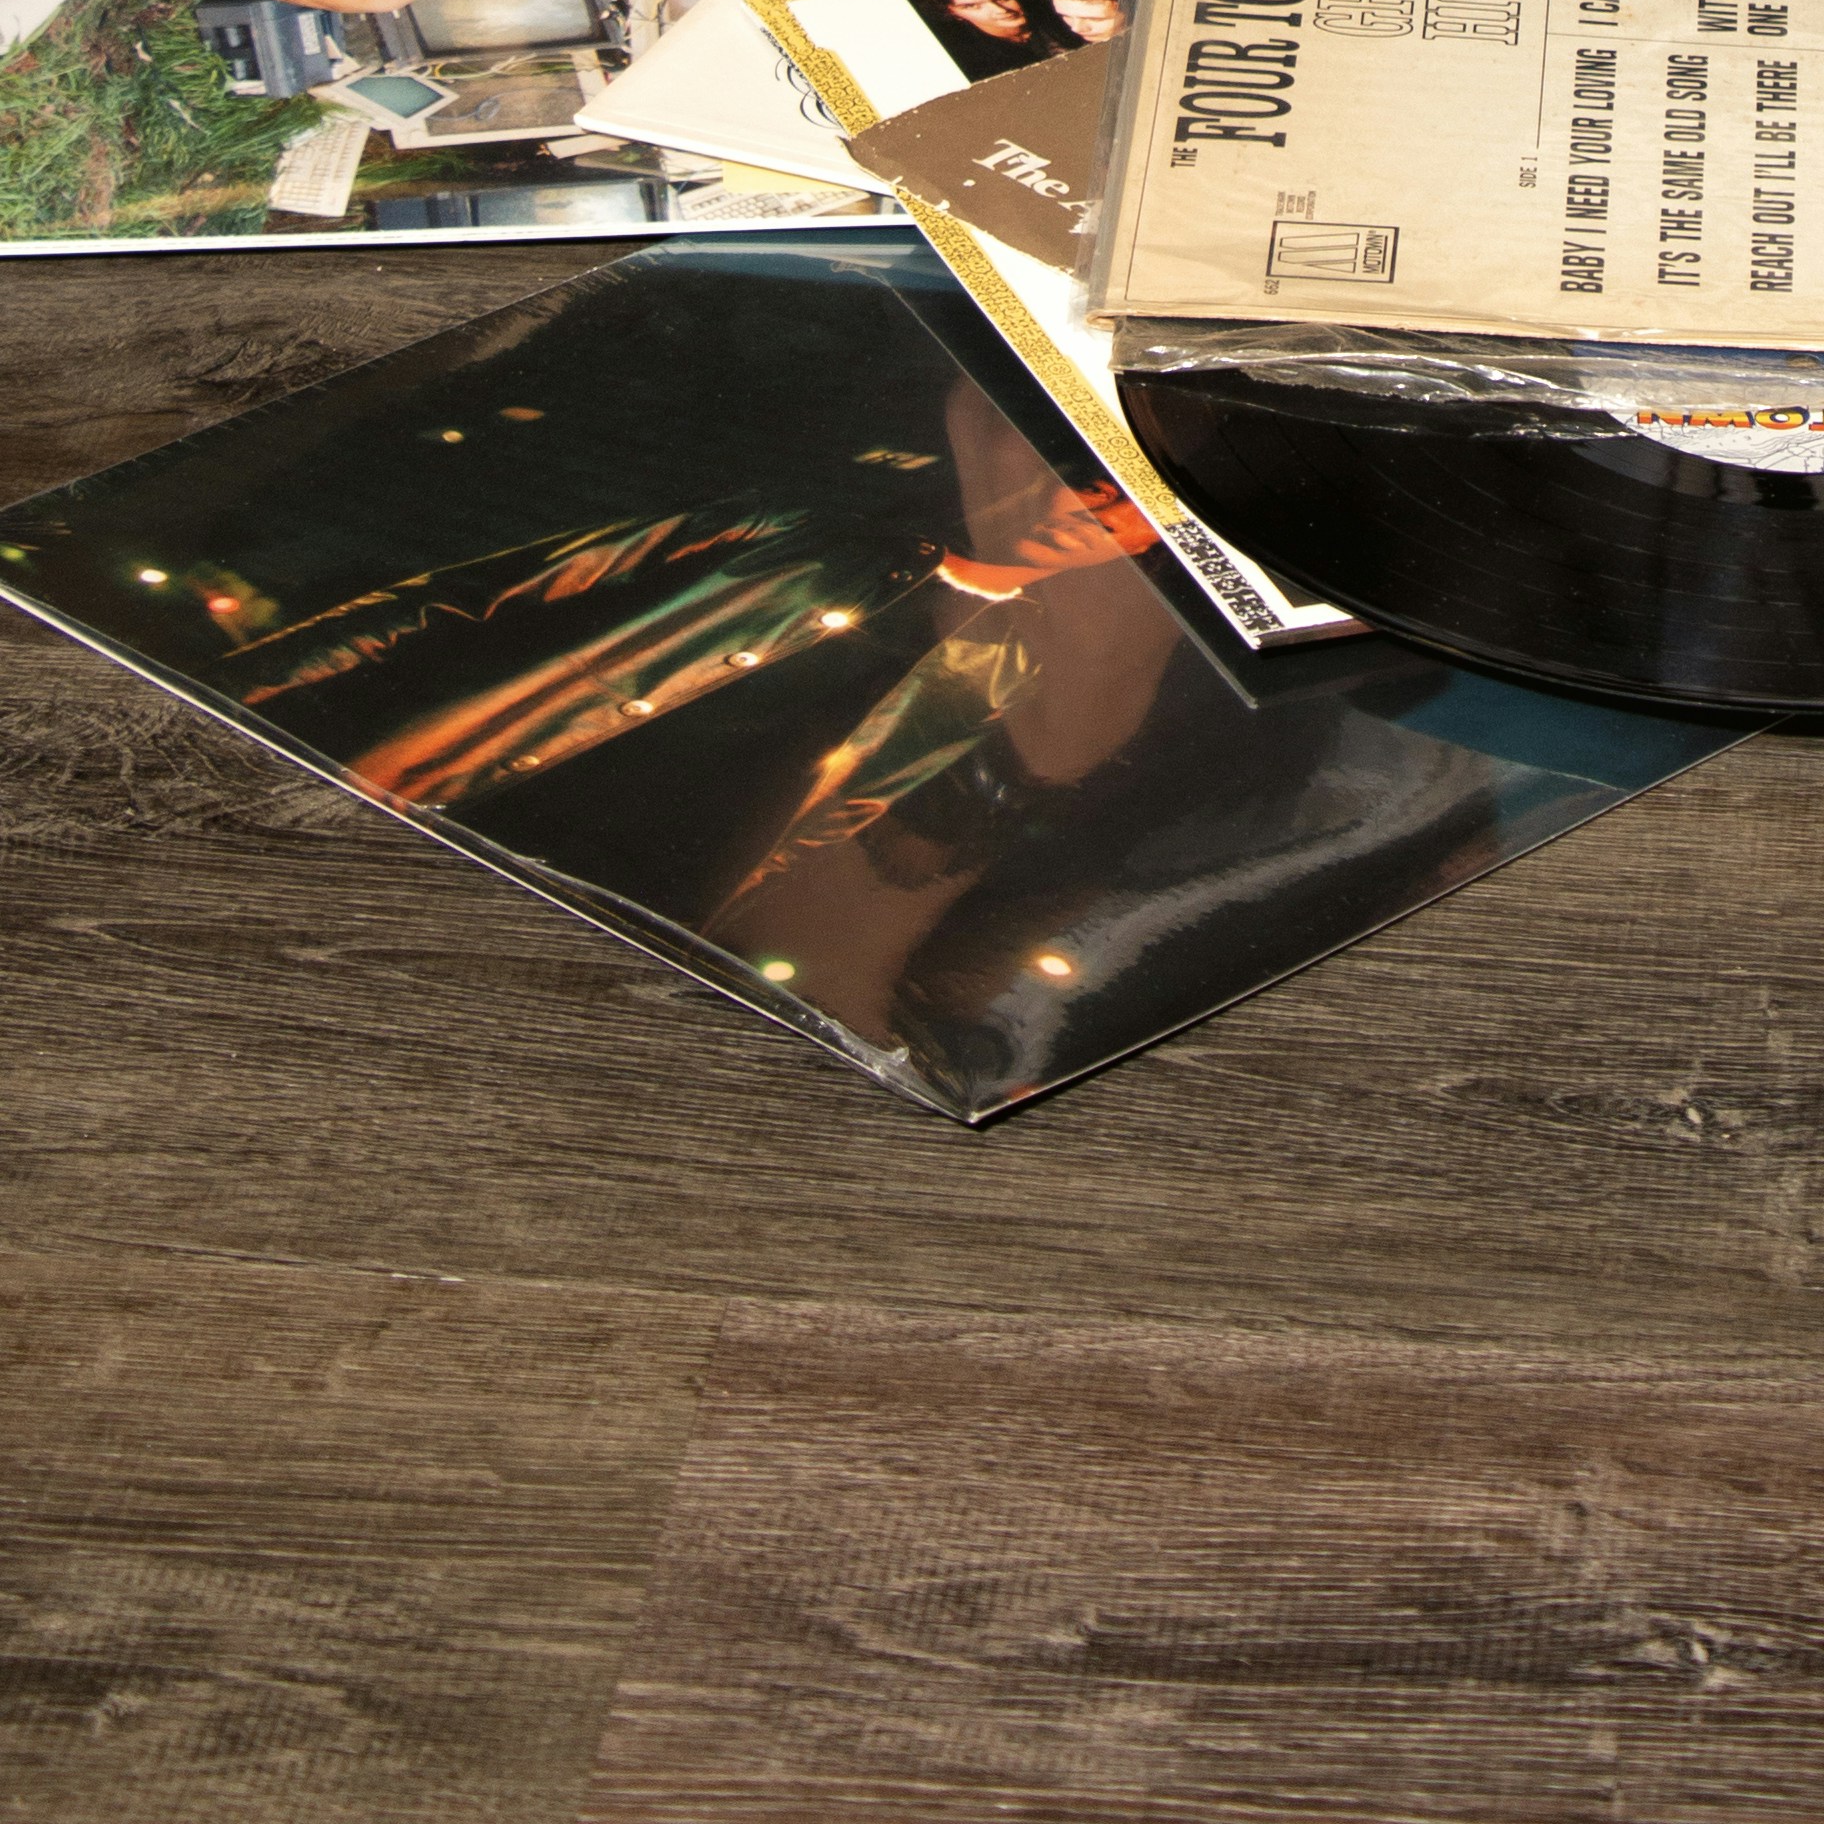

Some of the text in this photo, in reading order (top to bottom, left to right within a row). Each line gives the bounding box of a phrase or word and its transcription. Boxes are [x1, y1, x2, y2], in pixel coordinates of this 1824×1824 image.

[1747, 4, 1788, 36] ONE
[1174, 39, 1300, 147] FOUR
[1573, 48, 1617, 110] LOVING
[1170, 146, 1198, 168] THE
[1569, 117, 1613, 165] YOUR
[971, 138, 1070, 198] The
[1519, 167, 1537, 188] SIDE
[1658, 55, 1709, 286] IT'S THE SAME OLD SONG
[1750, 60, 1797, 292] REACH OUT I'LL BE THERE
[1566, 174, 1610, 220] NEED
[1560, 241, 1605, 294] BABY
